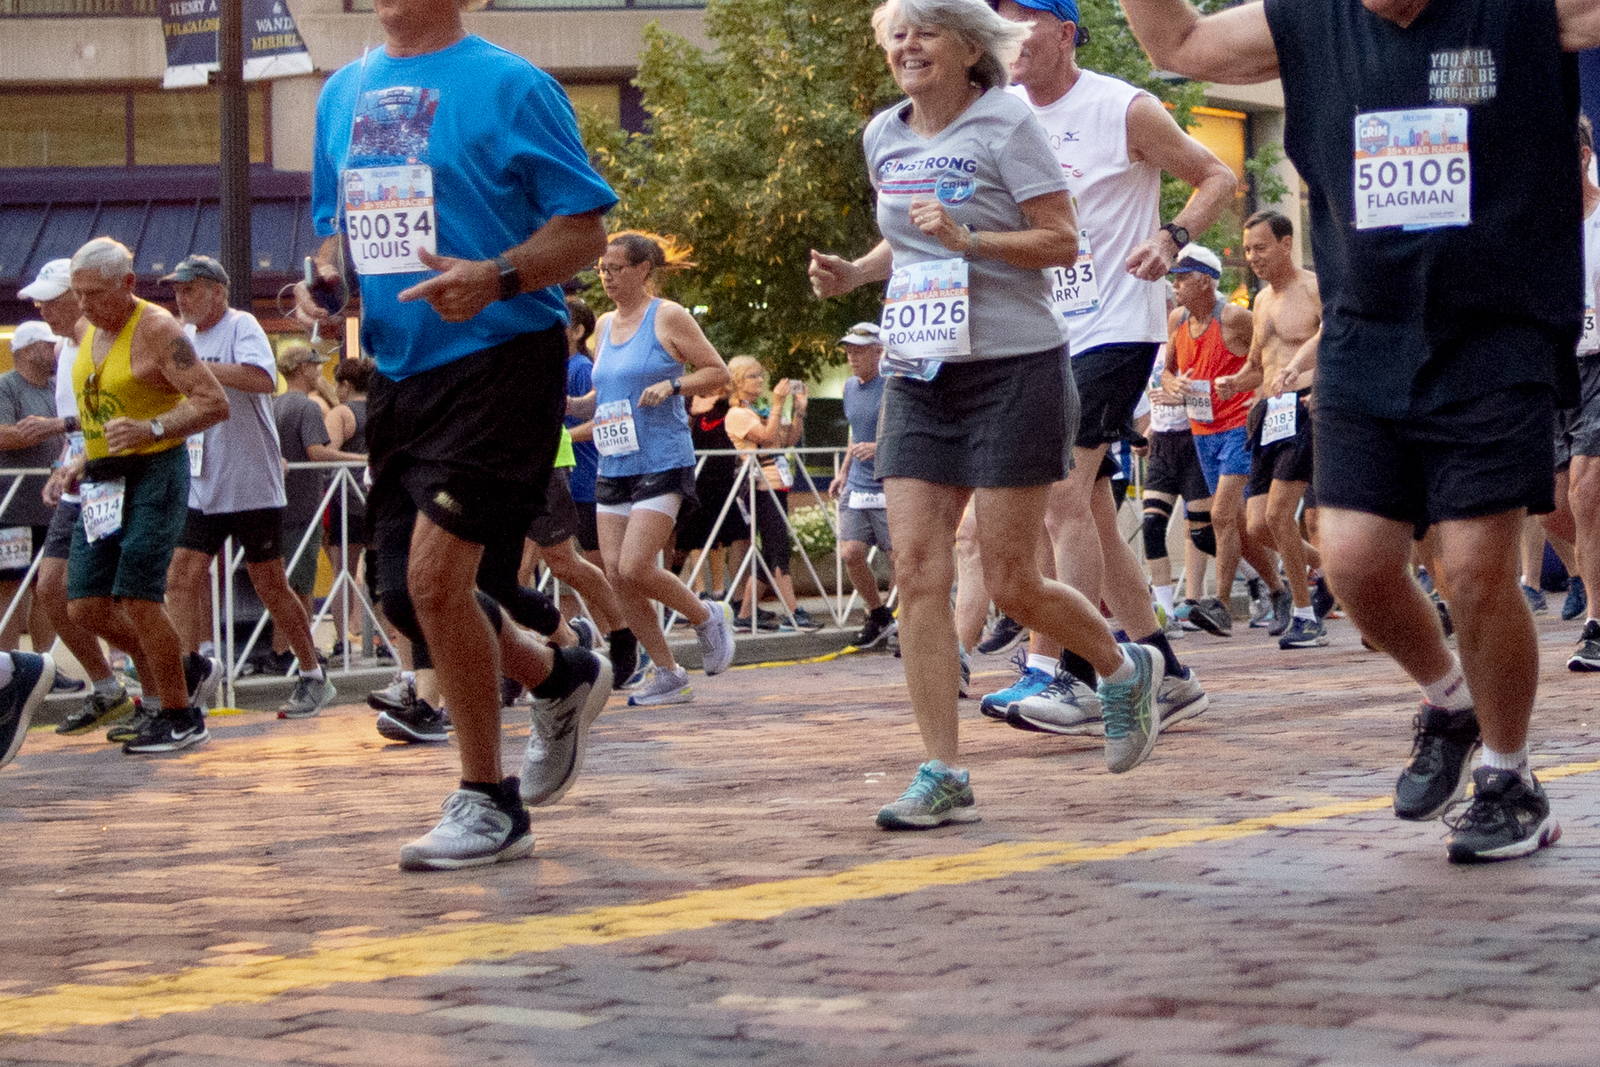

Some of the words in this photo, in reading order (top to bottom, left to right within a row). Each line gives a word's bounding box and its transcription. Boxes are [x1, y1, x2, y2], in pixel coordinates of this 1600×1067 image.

[1430, 52, 1458, 68] YOU
[1462, 49, 1495, 65] WILL
[1429, 69, 1476, 85] NEVER
[1478, 67, 1496, 83] BE
[1429, 85, 1497, 101] FORGOTTEN
[1360, 125, 1388, 138] CRIM
[1405, 145, 1429, 155] YEAR
[1431, 143, 1464, 154] RACER
[1358, 157, 1466, 191] 50106
[399, 197, 430, 207] RACER
[1367, 189, 1455, 209] FLAGMAN
[349, 210, 432, 241] 50034
[362, 240, 411, 259] LOUIS
[919, 290, 939, 299] YEAR
[940, 288, 965, 297] RACER
[883, 300, 966, 330] 50126
[888, 327, 957, 345] ROXANNE
[597, 423, 629, 440] 1366
